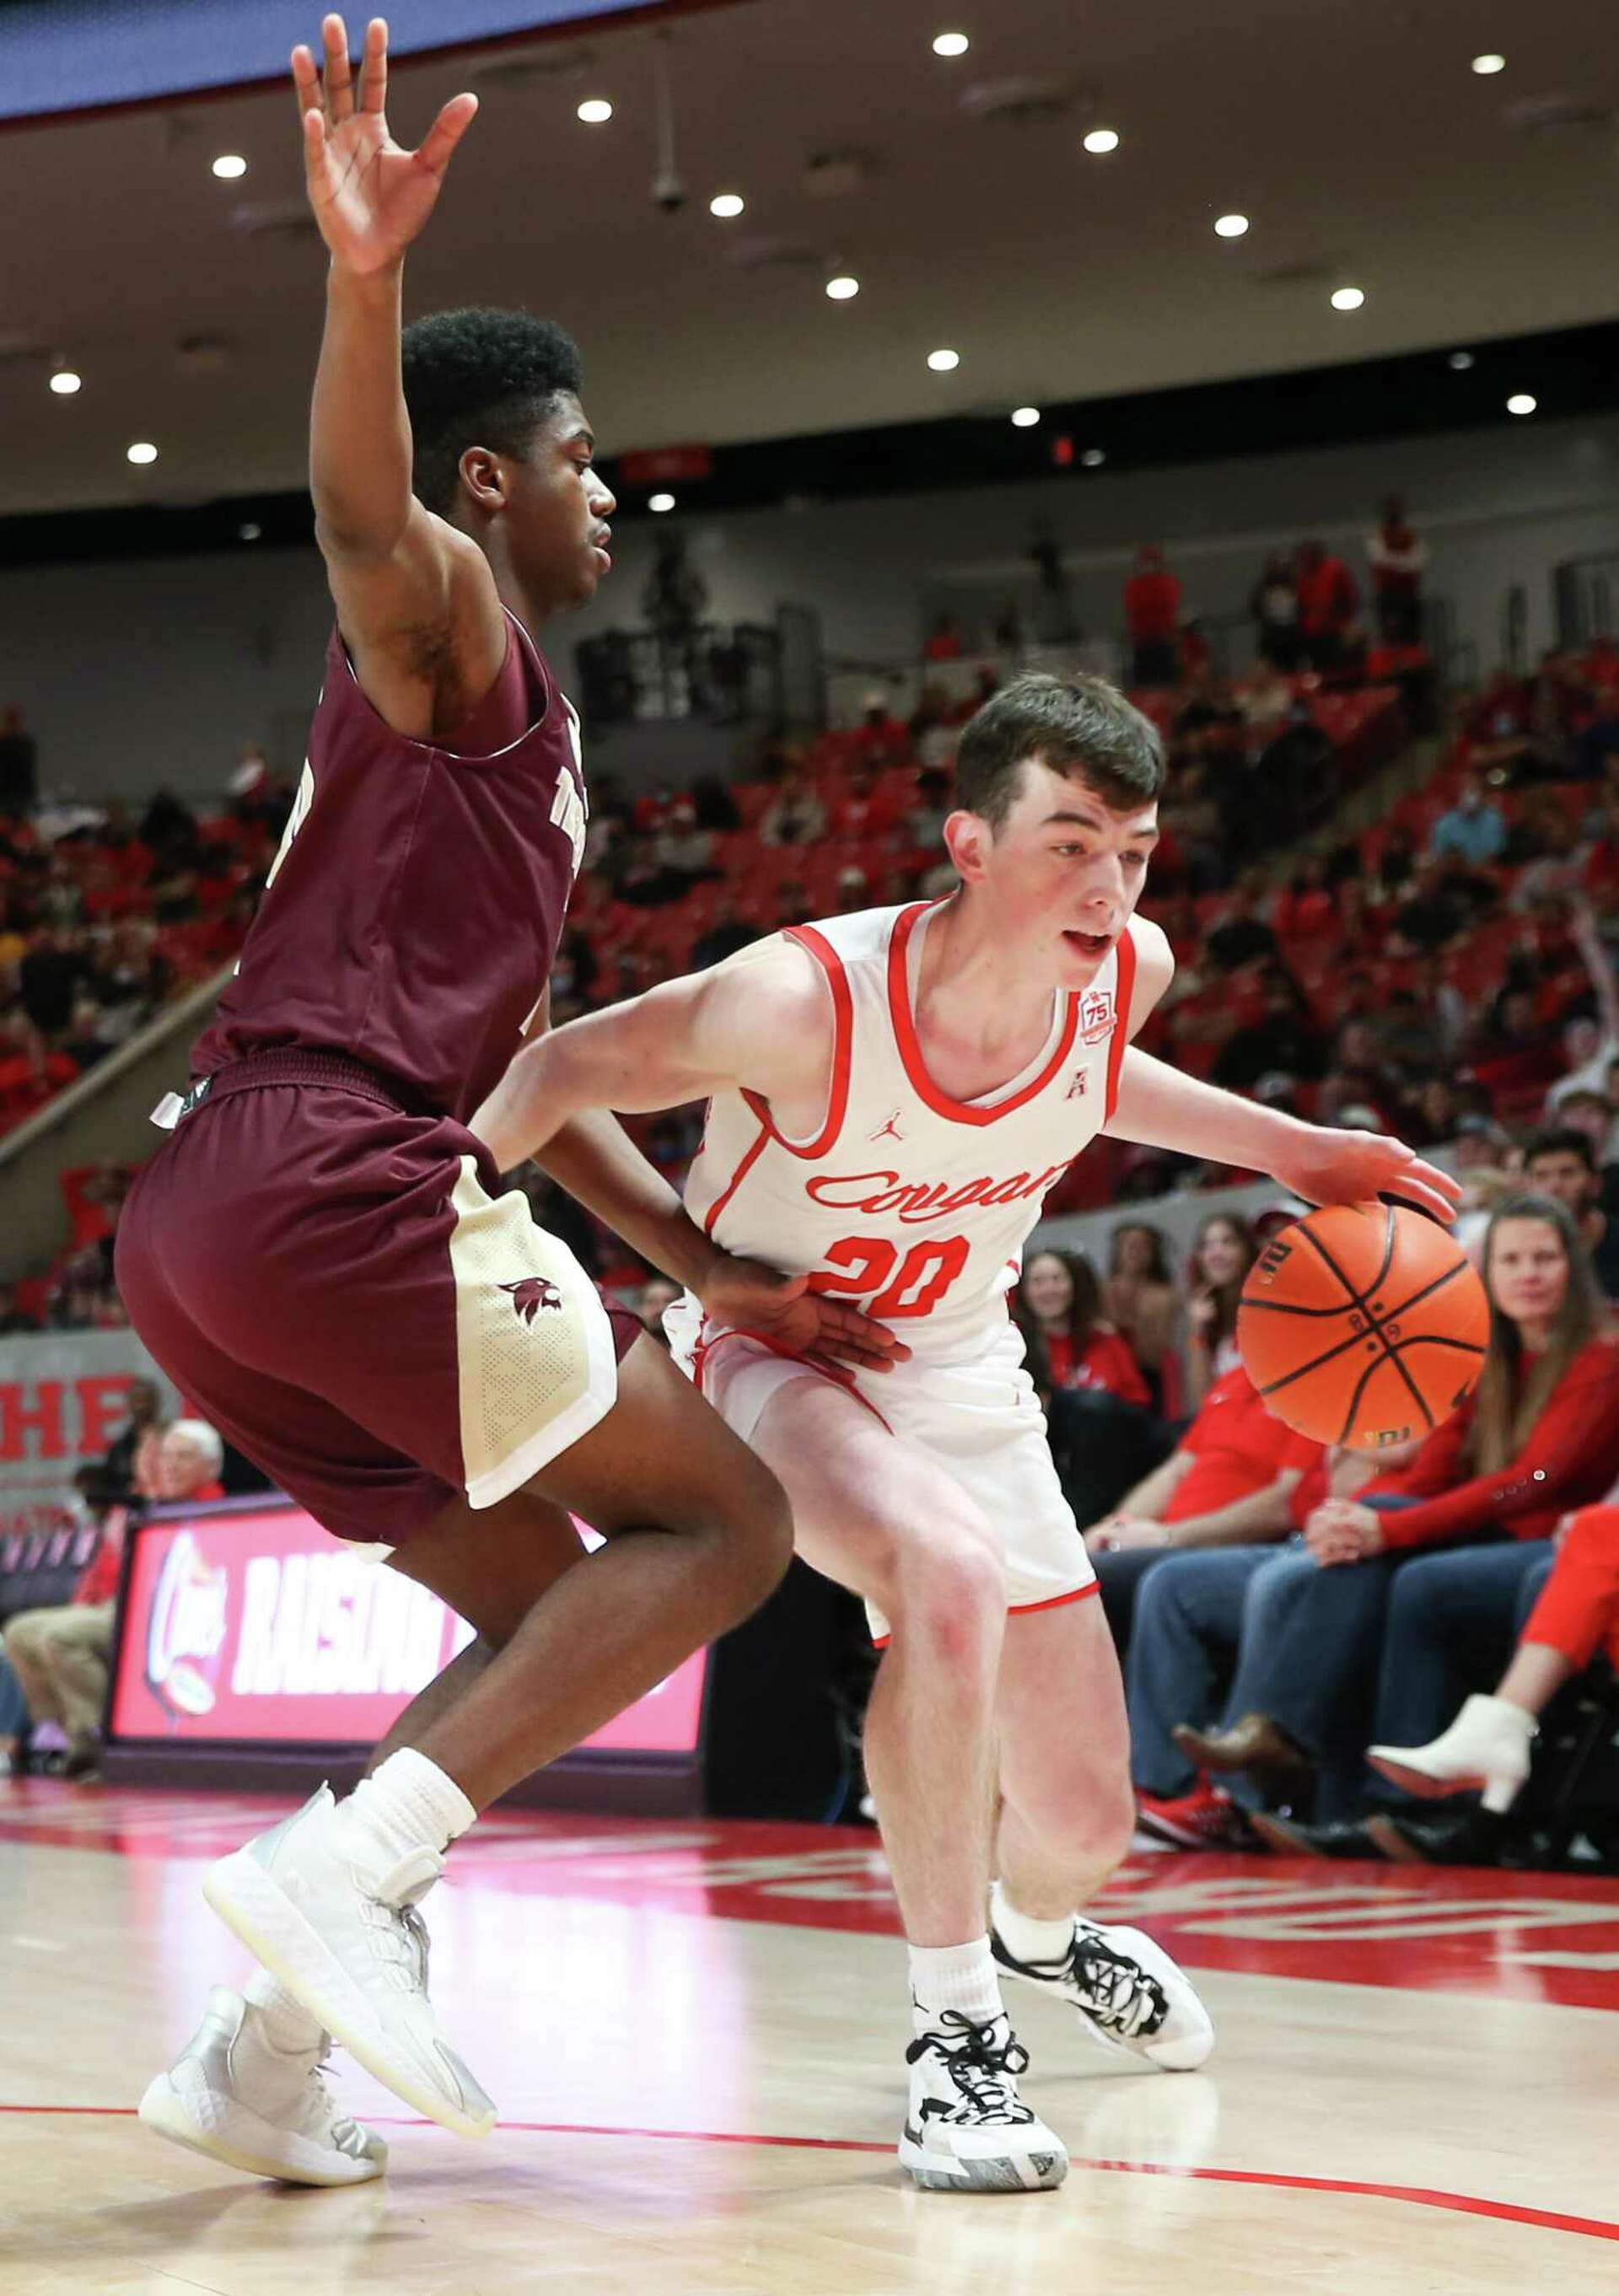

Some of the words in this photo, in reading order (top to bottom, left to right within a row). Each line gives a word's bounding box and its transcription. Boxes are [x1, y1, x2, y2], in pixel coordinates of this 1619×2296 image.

[1086, 1003, 1107, 1026] 75
[806, 1161, 1076, 1223] Cougar
[809, 1235, 971, 1318] 20
